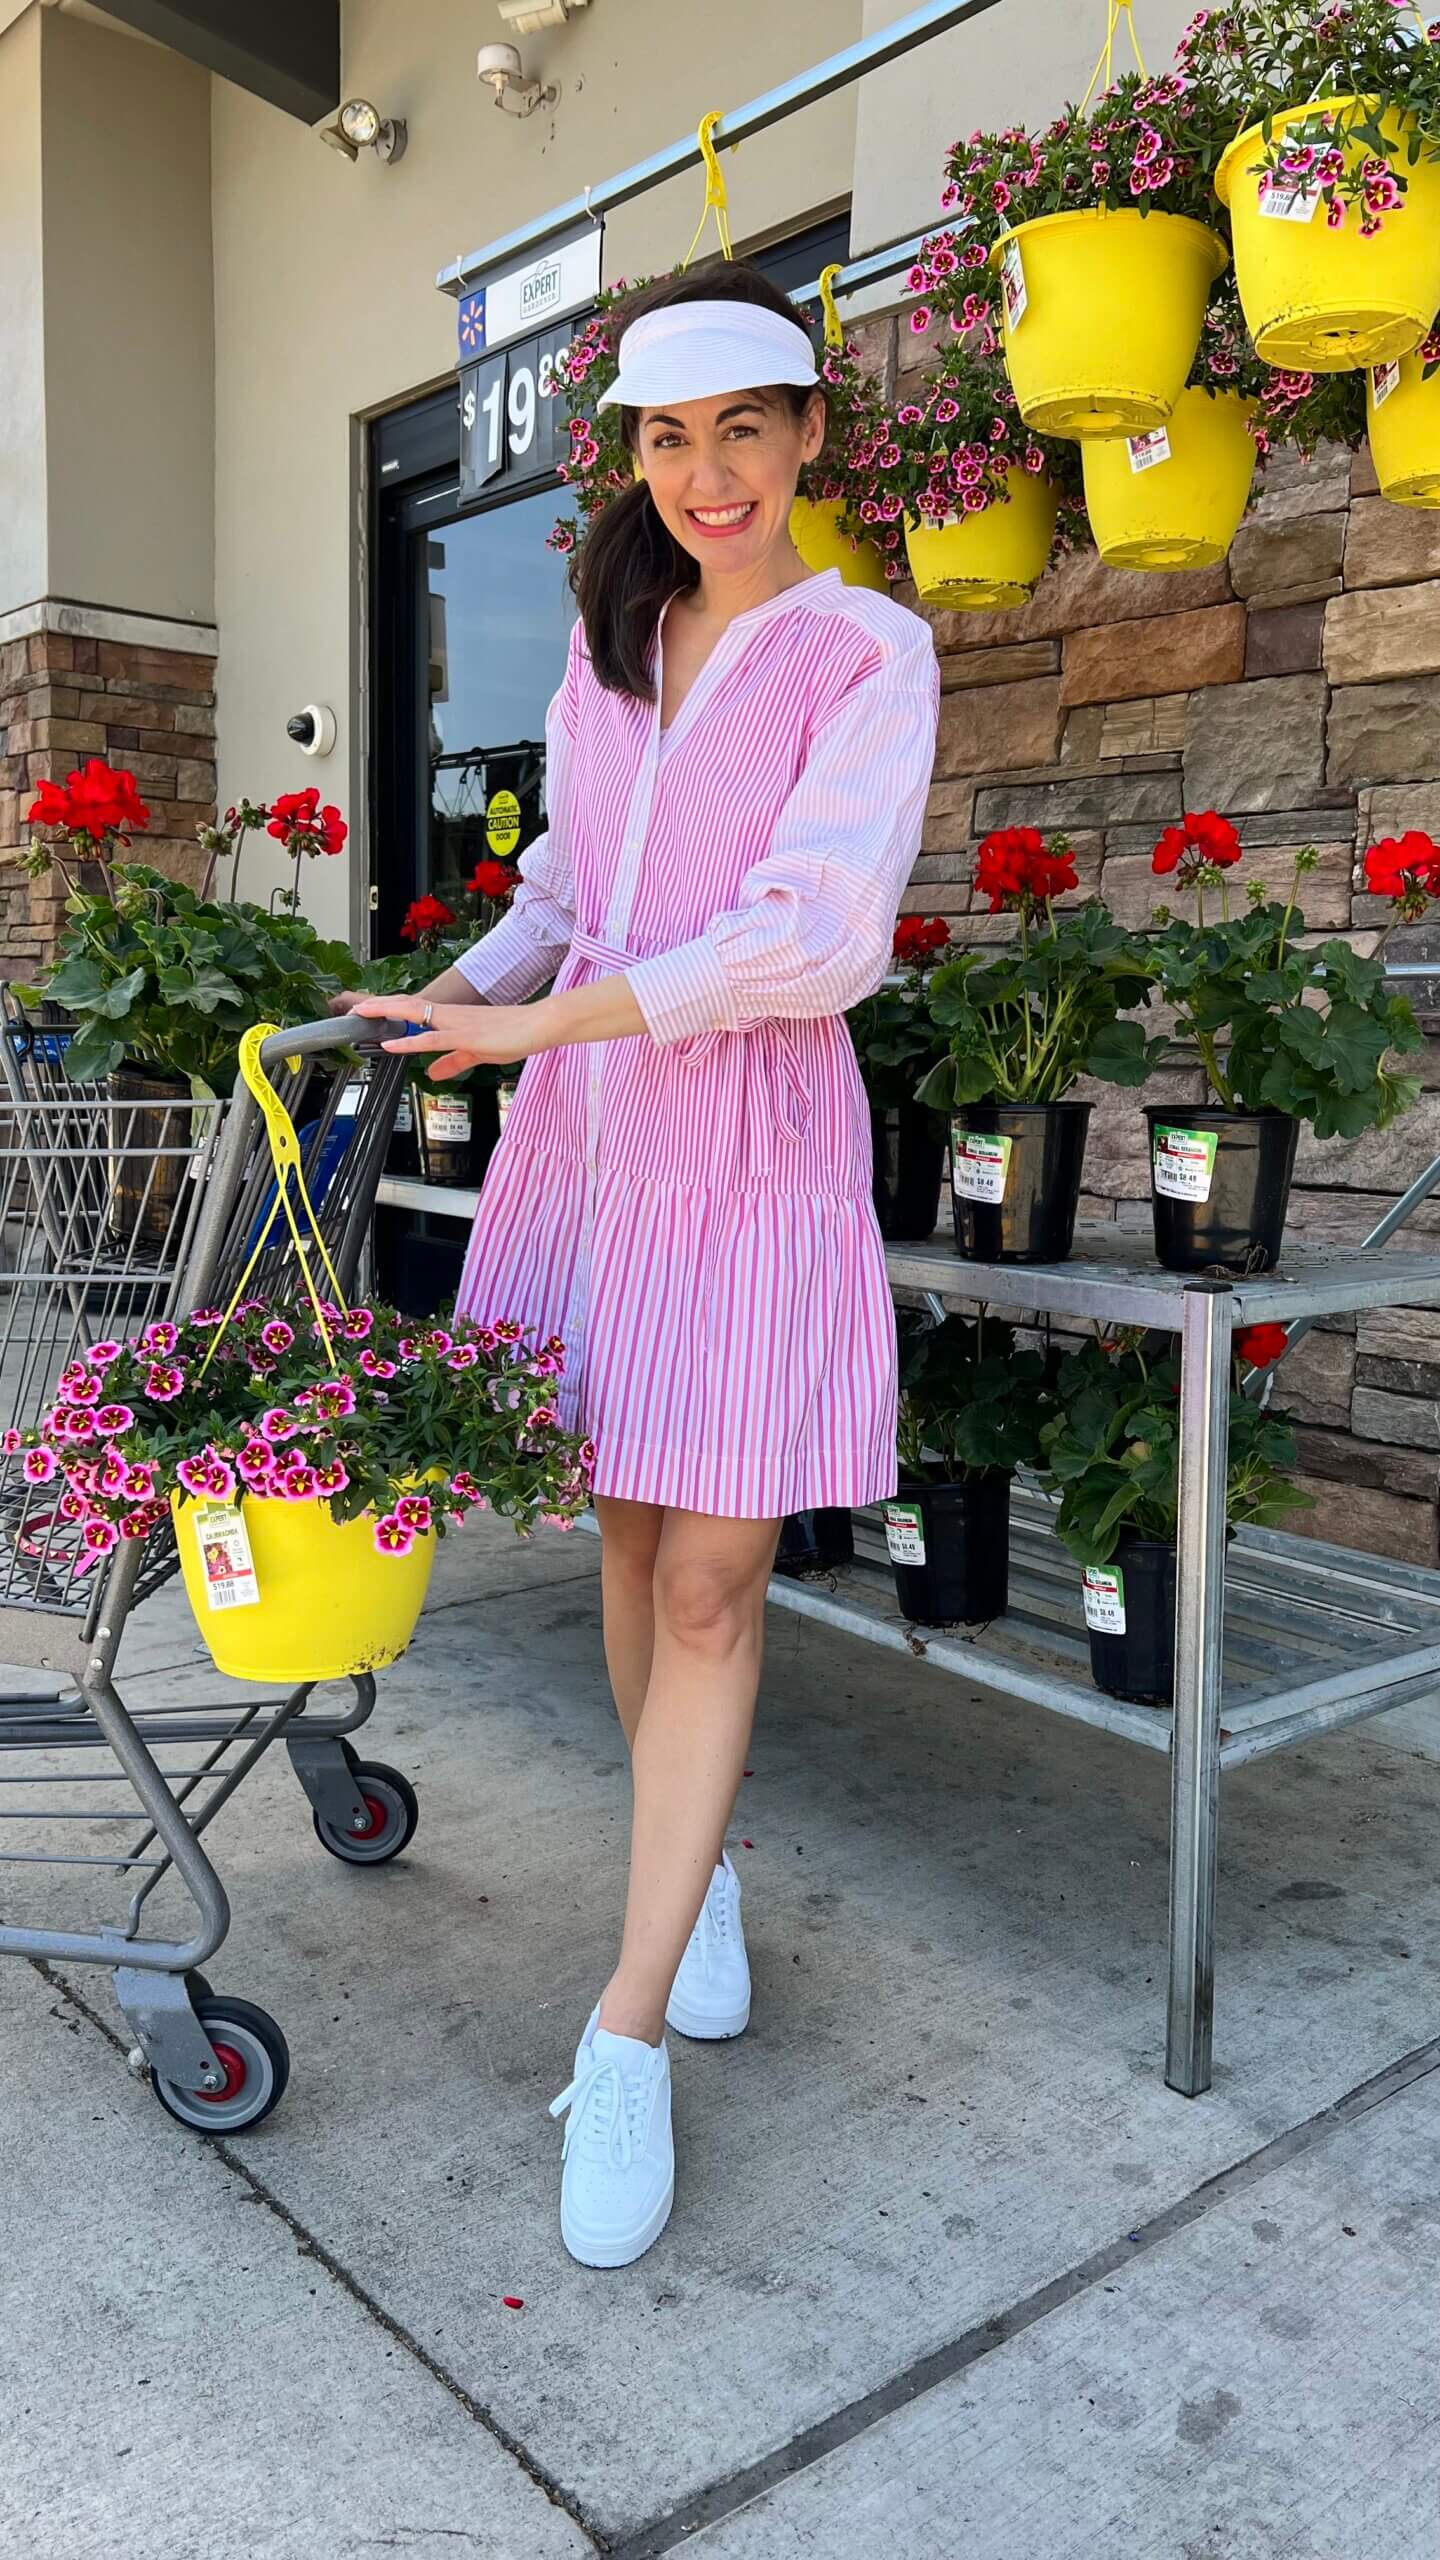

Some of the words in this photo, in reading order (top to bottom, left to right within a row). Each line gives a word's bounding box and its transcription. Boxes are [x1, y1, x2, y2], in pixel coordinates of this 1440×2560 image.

[523, 270, 558, 304] EXPERT
[488, 816, 520, 830] CAUTION
[496, 832, 511, 841] DOOR
